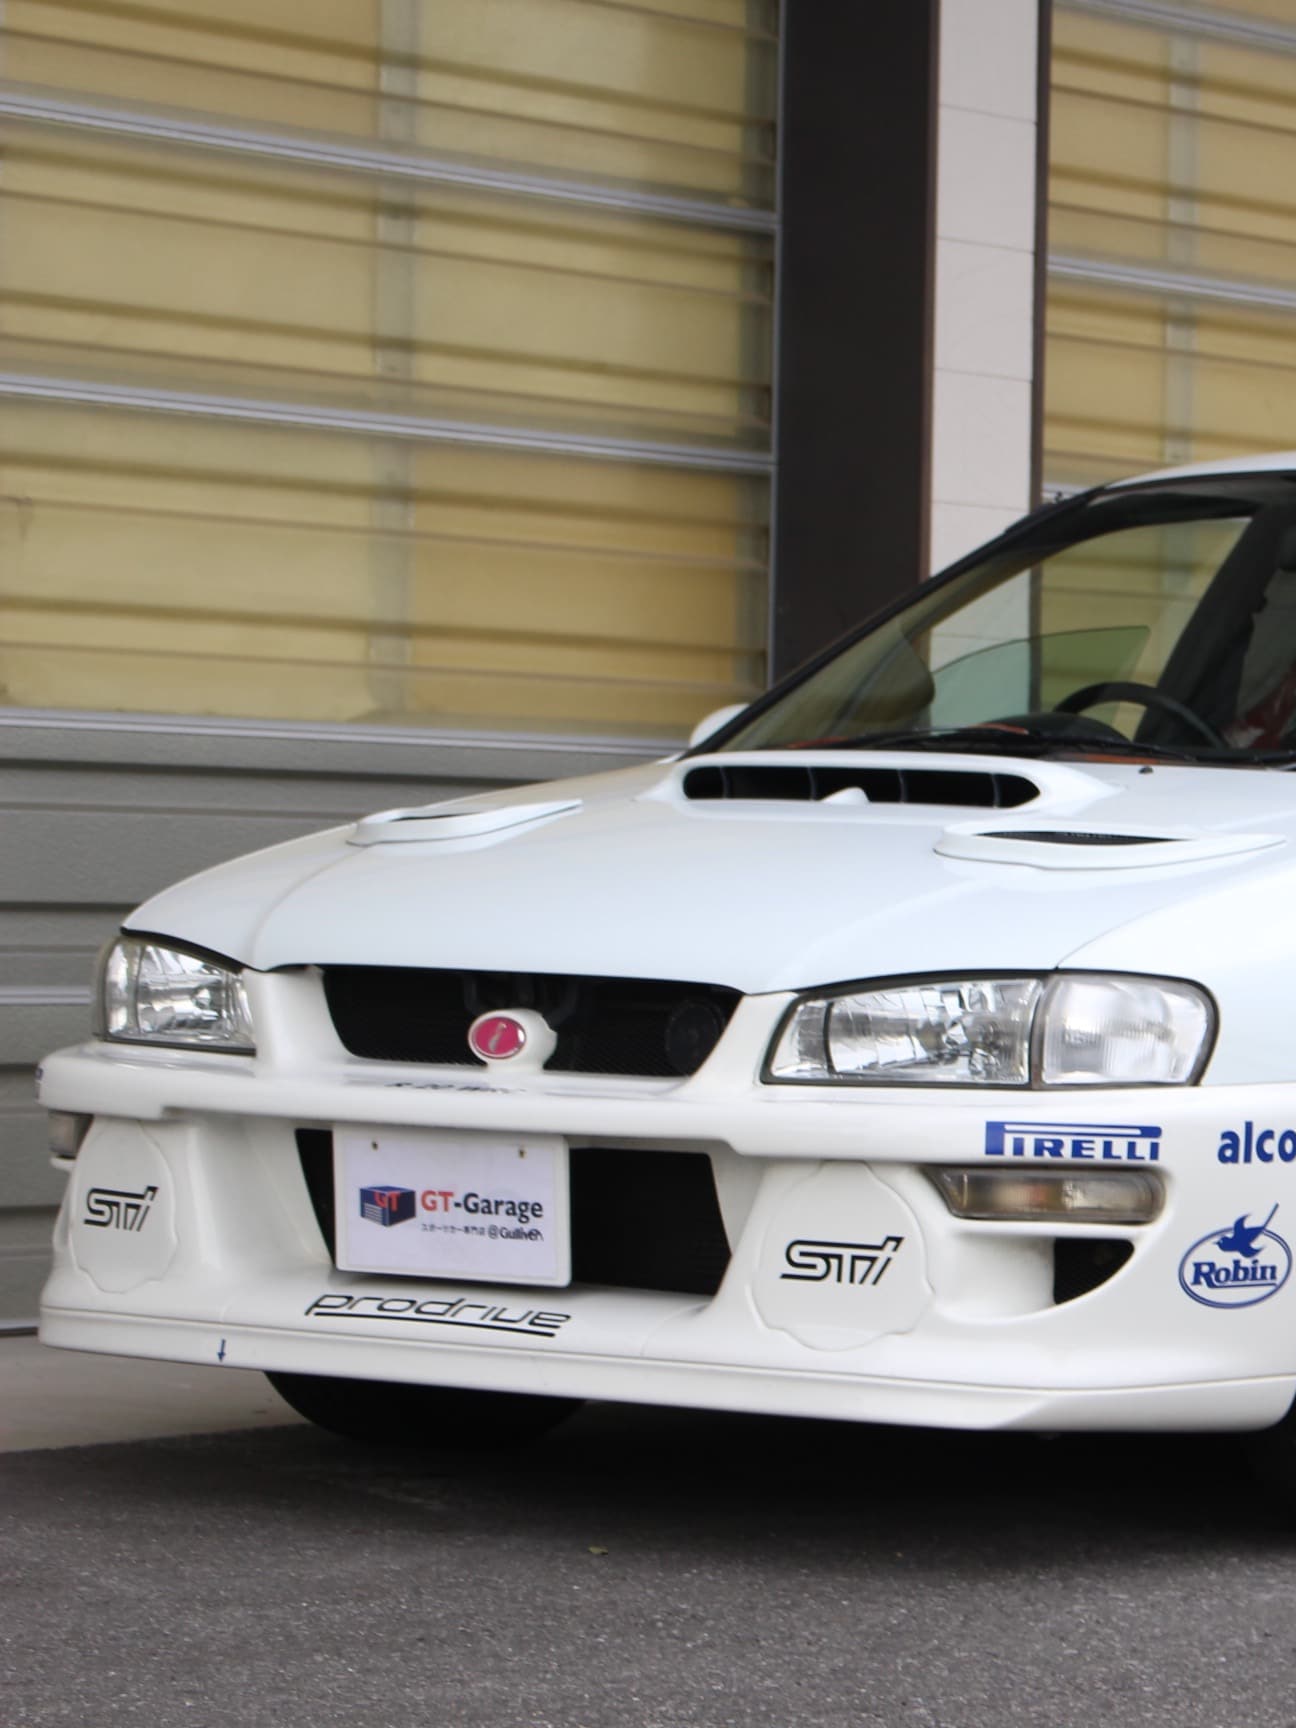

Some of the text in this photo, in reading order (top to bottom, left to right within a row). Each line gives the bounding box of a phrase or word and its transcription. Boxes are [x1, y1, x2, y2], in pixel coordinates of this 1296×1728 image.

[985, 1121, 1162, 1161] PIRELLI
[421, 1190, 544, 1224] GT-Garage
[1191, 1259, 1278, 1289] Robin
[304, 1294, 571, 1330] prodrive
